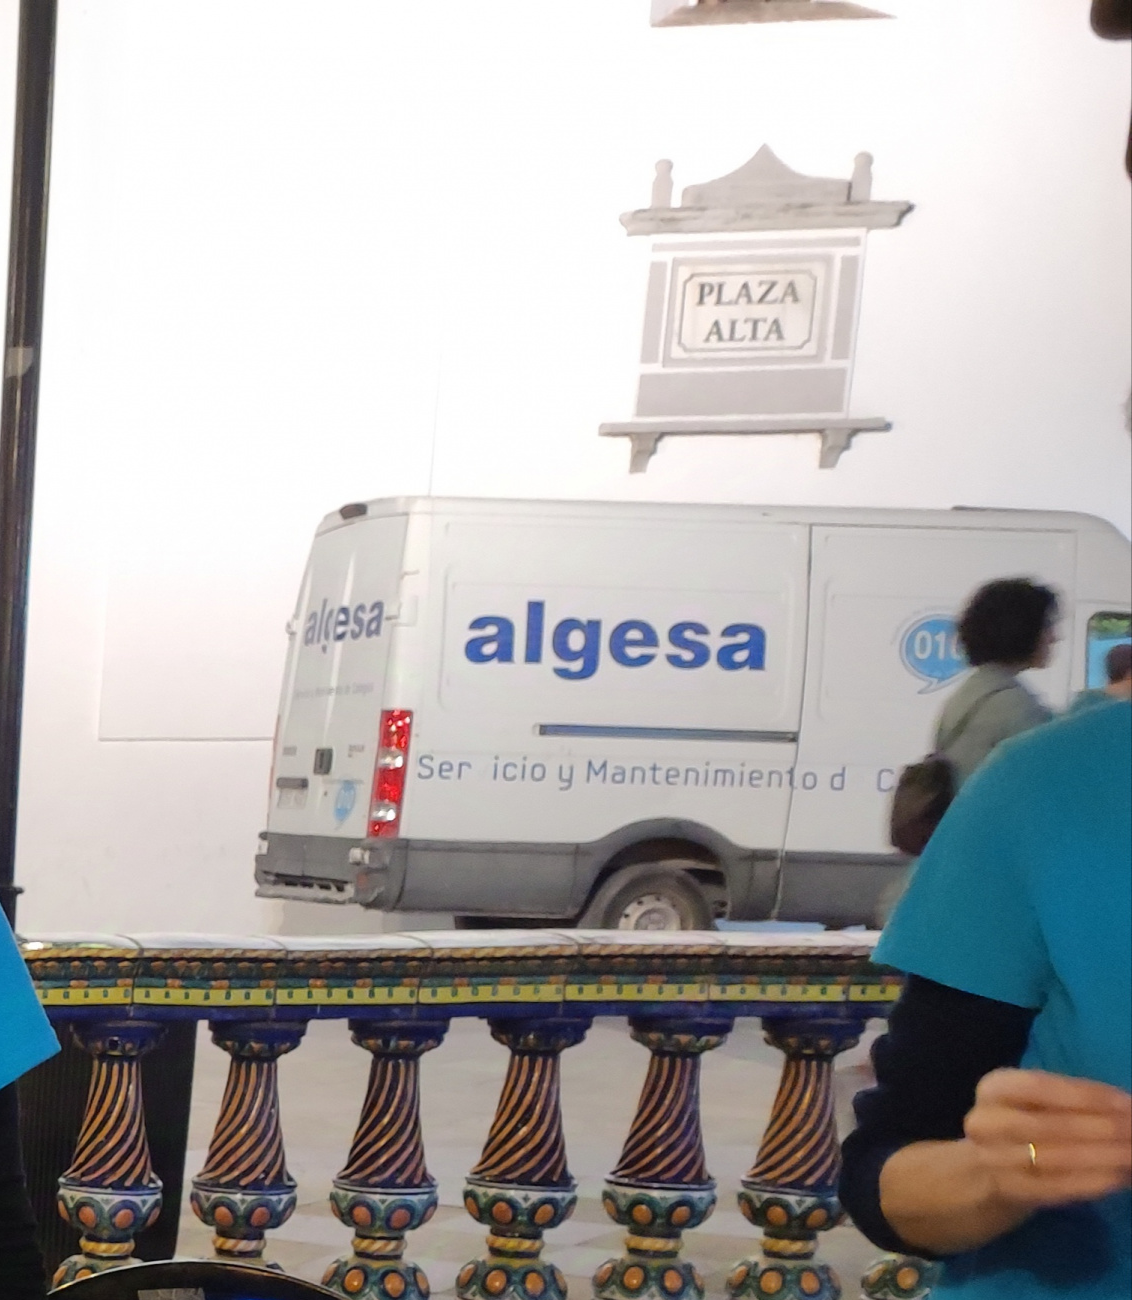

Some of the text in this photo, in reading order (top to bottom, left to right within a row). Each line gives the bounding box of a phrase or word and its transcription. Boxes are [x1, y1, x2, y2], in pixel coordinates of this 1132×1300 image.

[696, 279, 801, 306] PLAZA
[702, 317, 786, 343] ALTA
[464, 600, 766, 680] algesa
[558, 764, 575, 791] y
[585, 758, 818, 791] Mantenimiento
